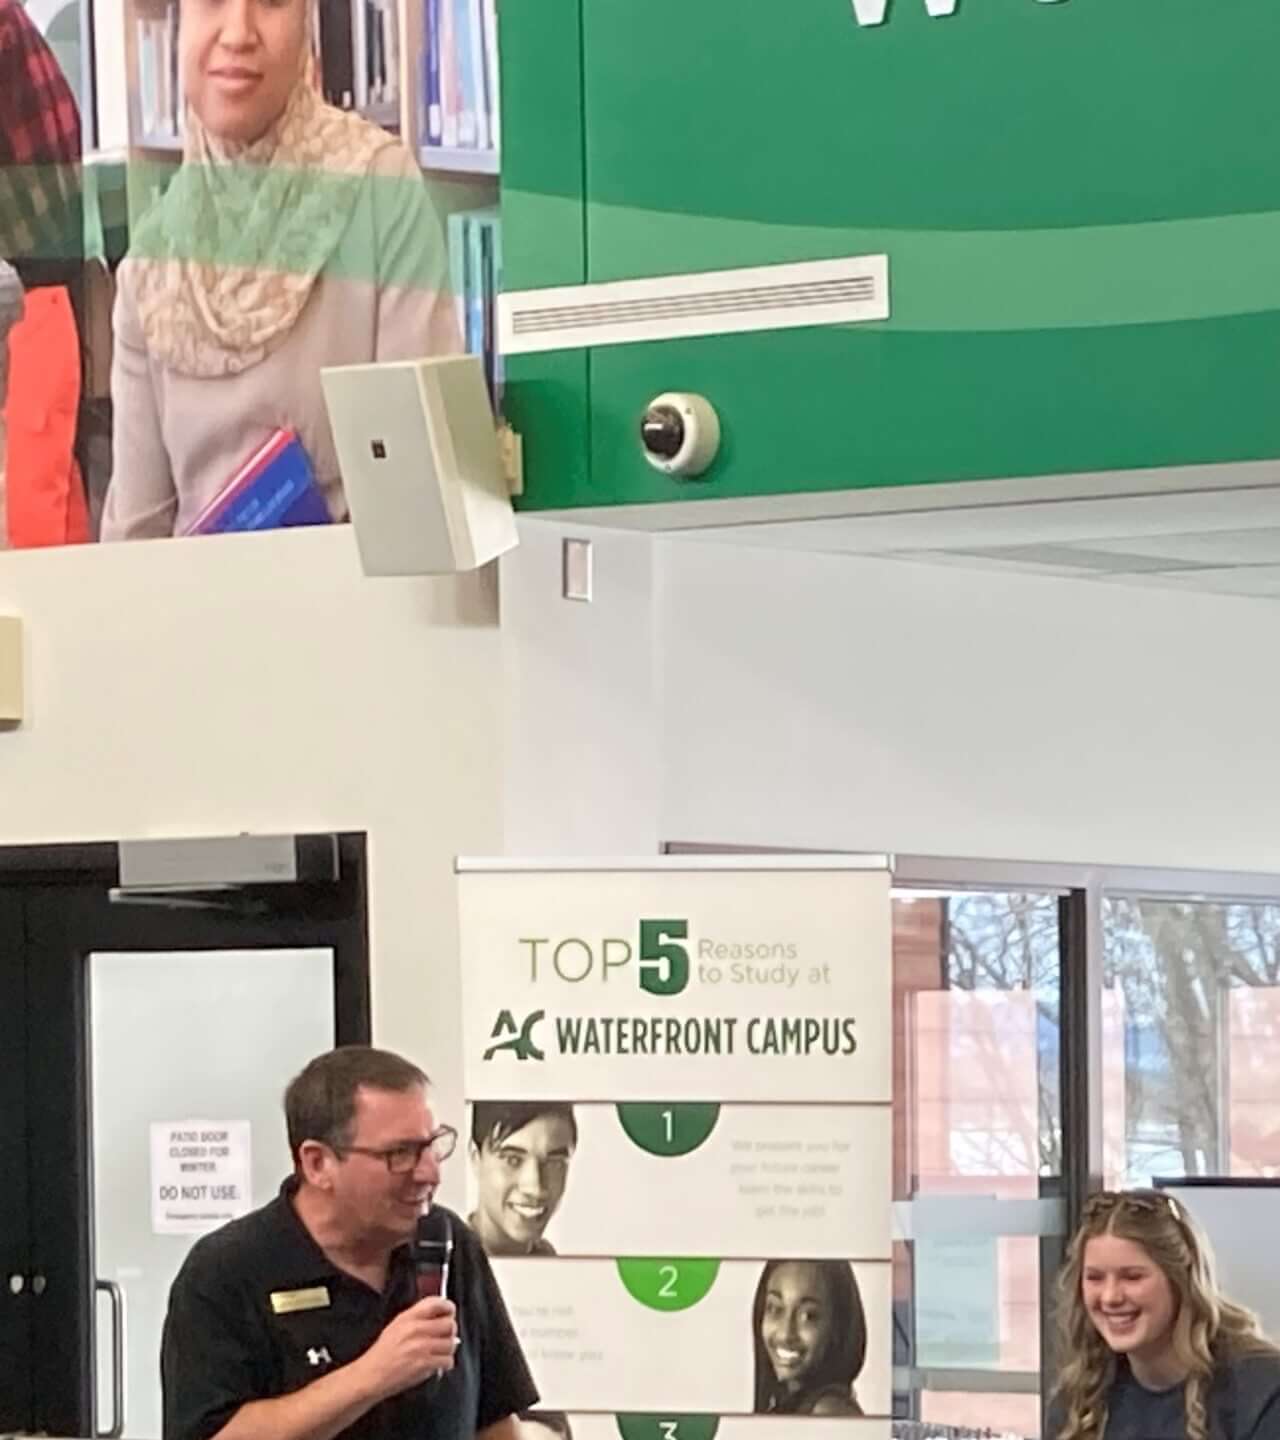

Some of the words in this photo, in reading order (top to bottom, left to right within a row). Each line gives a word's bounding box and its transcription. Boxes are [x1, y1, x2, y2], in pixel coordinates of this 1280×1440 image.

[518, 937, 632, 983] TOP
[639, 918, 690, 996] 5
[697, 938, 798, 961] Reasons
[697, 964, 722, 984] to
[730, 963, 800, 987] Study
[807, 964, 831, 984] at
[556, 1016, 737, 1055] WATERFRONT
[746, 1016, 858, 1055] CAMPUS
[661, 1111, 673, 1142] 1
[159, 1186, 179, 1201] DO
[181, 1186, 207, 1200] NOT
[210, 1186, 240, 1200] USE.
[658, 1266, 678, 1297] 2
